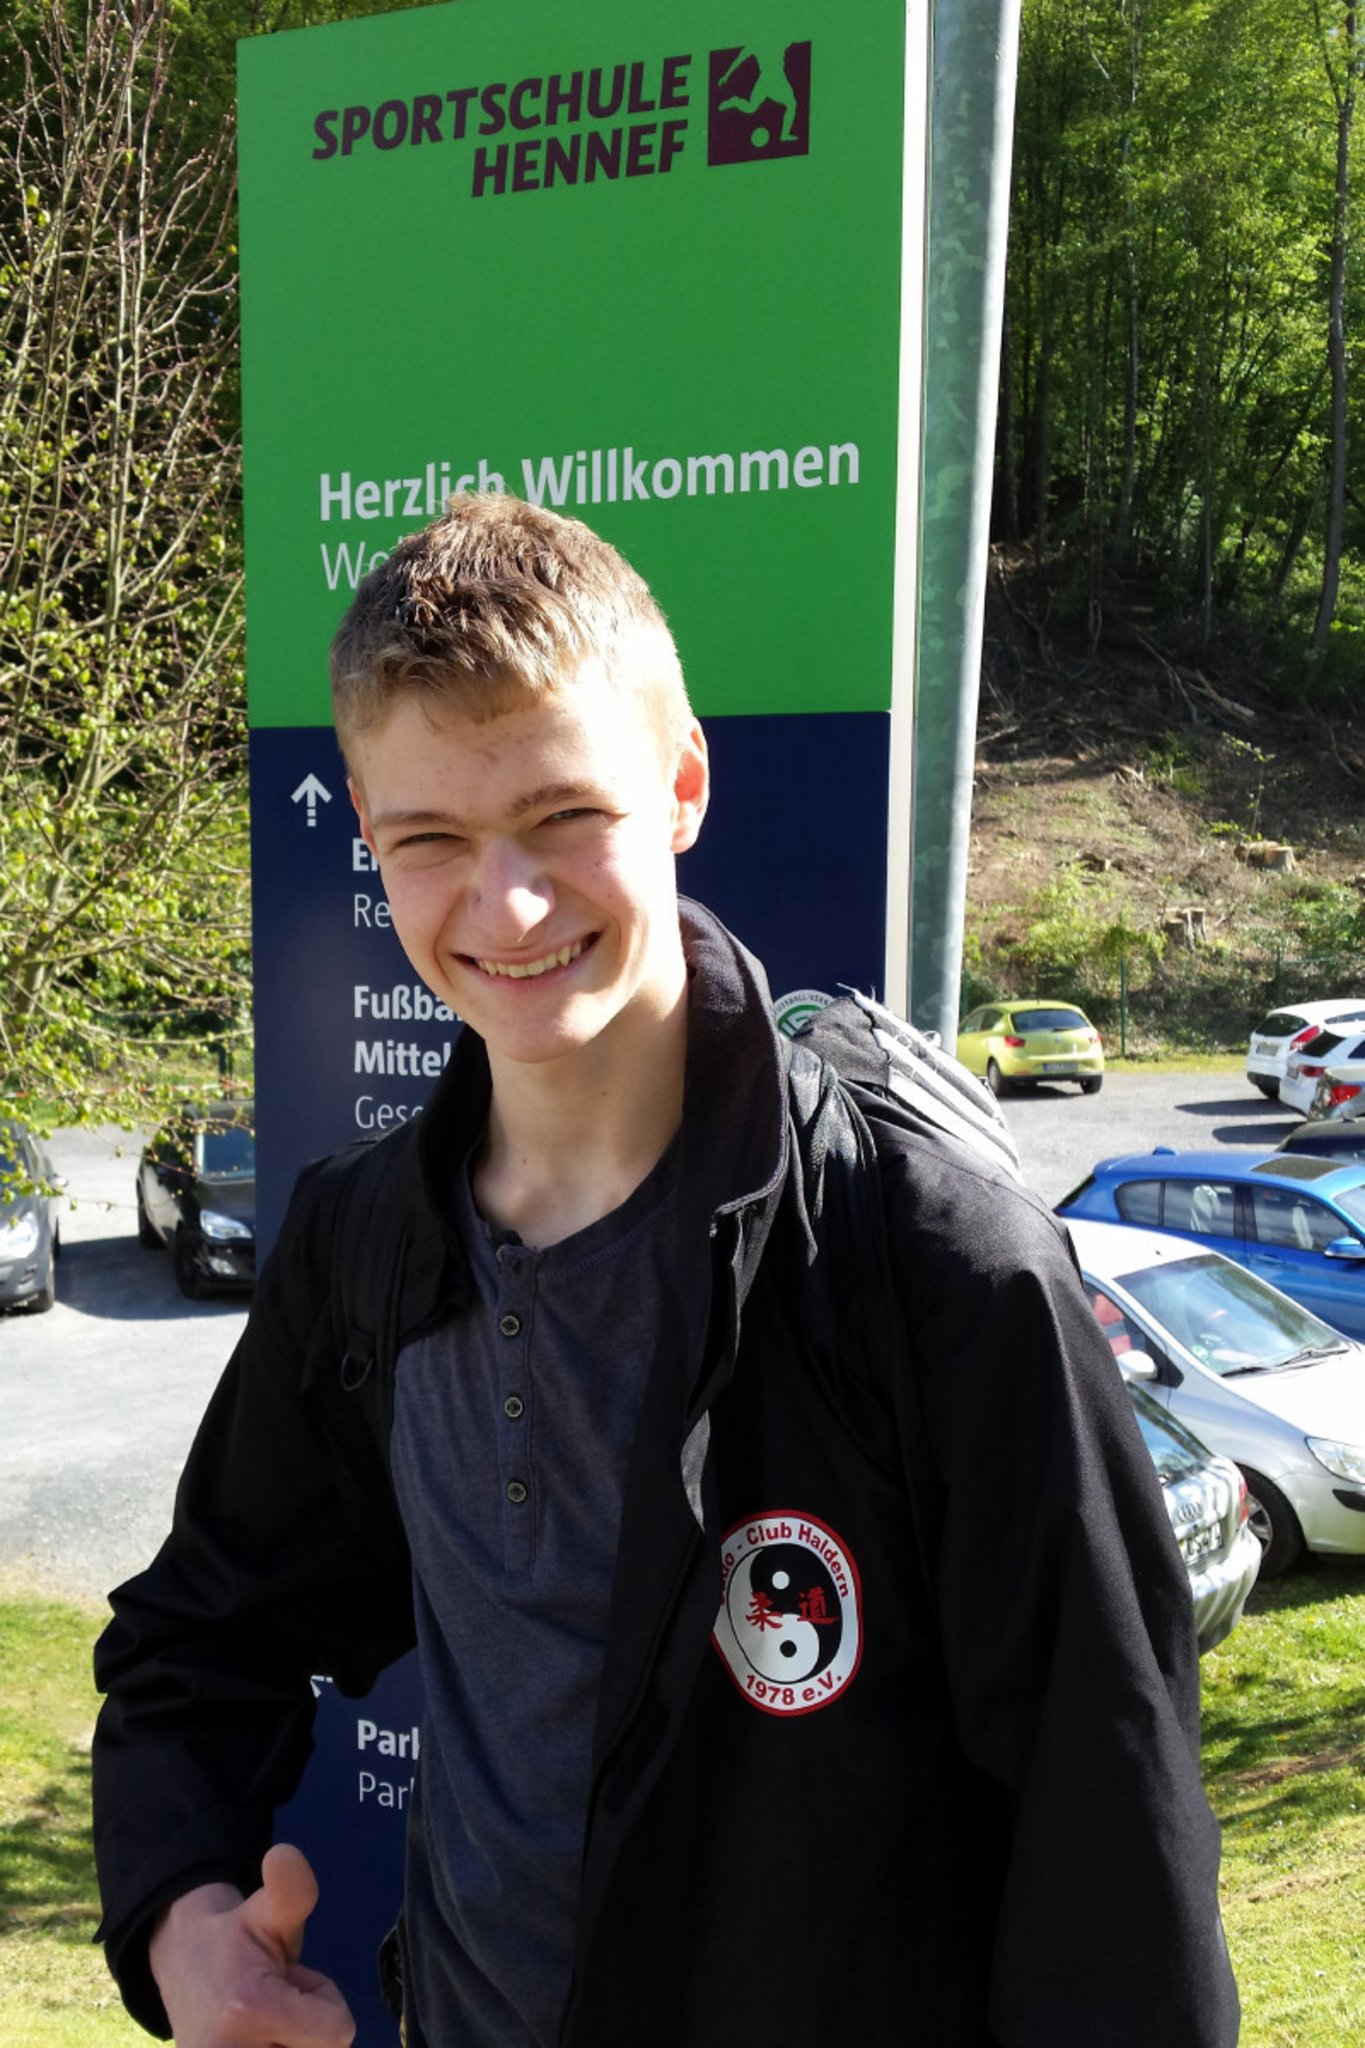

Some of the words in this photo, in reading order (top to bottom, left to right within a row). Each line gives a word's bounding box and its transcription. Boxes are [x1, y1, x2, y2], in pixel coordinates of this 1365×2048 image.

[311, 54, 692, 160] SPORTSCHULE
[471, 118, 689, 198] HENNEF
[521, 442, 860, 507] Willkommen
[354, 984, 463, 1022] Fußba
[746, 1522, 792, 1545] Club
[798, 1524, 849, 1598] Haldern
[745, 1586, 840, 1632] 柔道
[746, 1674, 795, 1706] 1978
[802, 1671, 842, 1702] e.V.
[359, 1771, 415, 1809] Par
